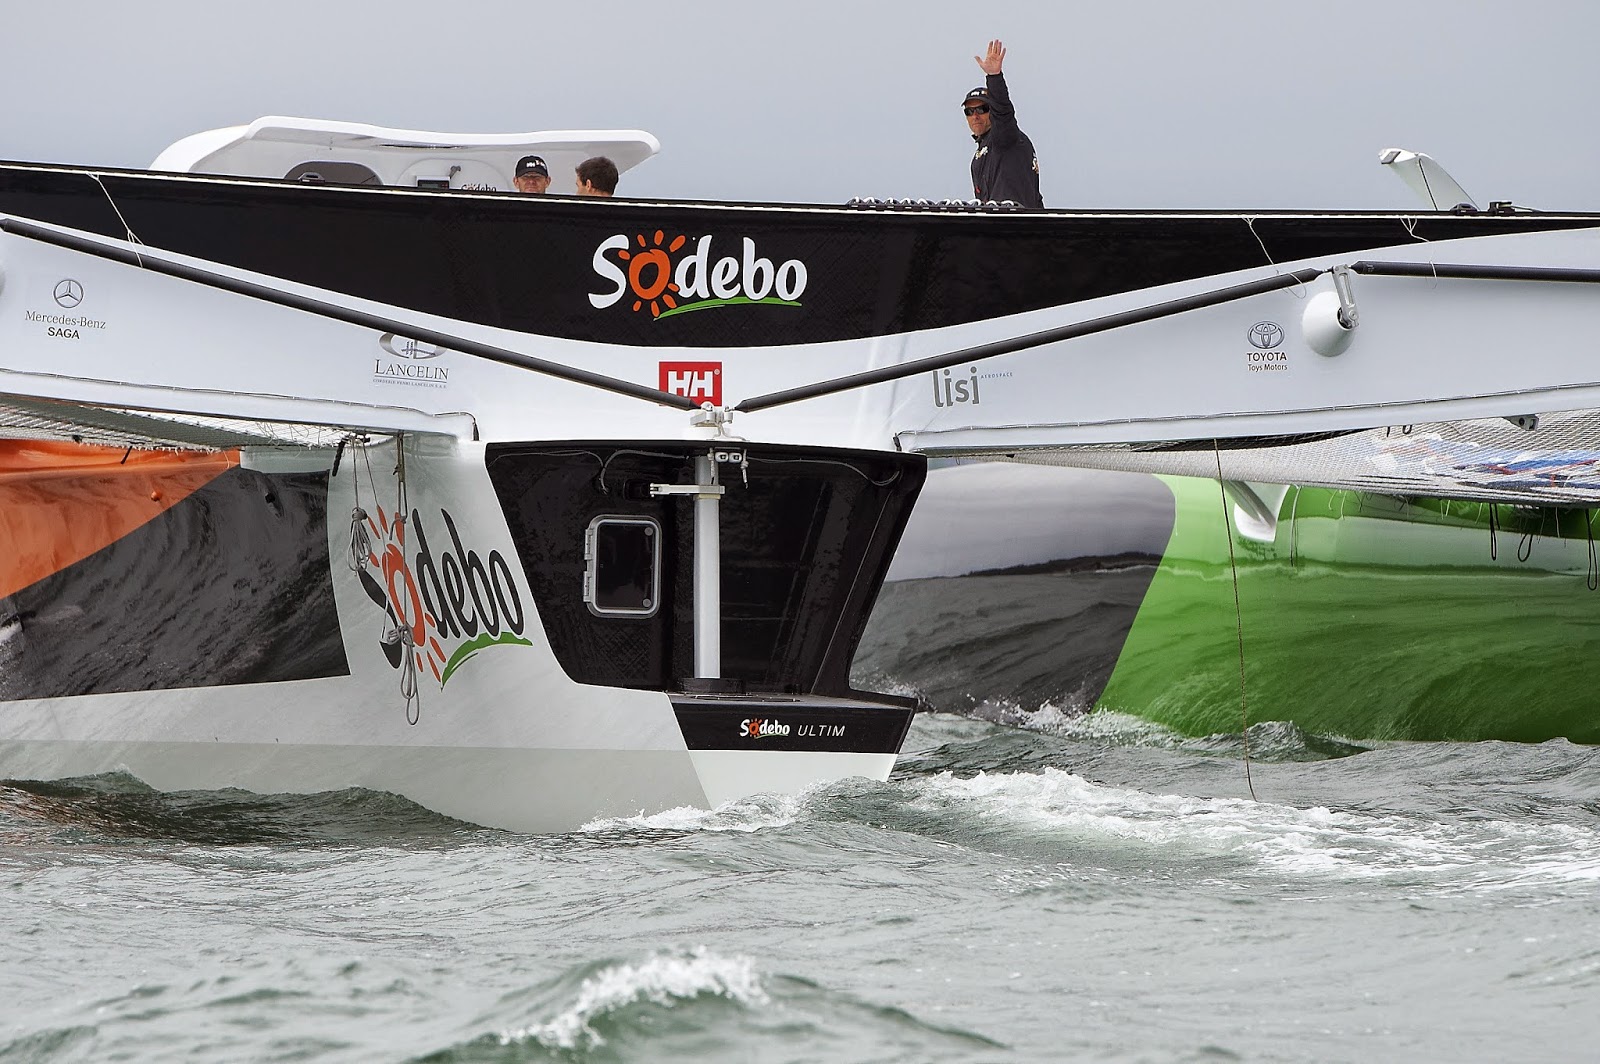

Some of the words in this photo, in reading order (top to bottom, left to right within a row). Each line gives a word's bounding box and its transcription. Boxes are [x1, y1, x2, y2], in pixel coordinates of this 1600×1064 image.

[588, 230, 807, 314] Sodebo
[25, 310, 106, 329] Mercedes-Benz
[48, 327, 80, 339] SAGA
[1247, 352, 1287, 361] TOYOTA
[375, 359, 449, 380] LANCELIN
[1248, 364, 1262, 372] Toys
[933, 366, 980, 408] lisi
[740, 718, 790, 738] Sodebo
[797, 724, 846, 737] ULTIM
